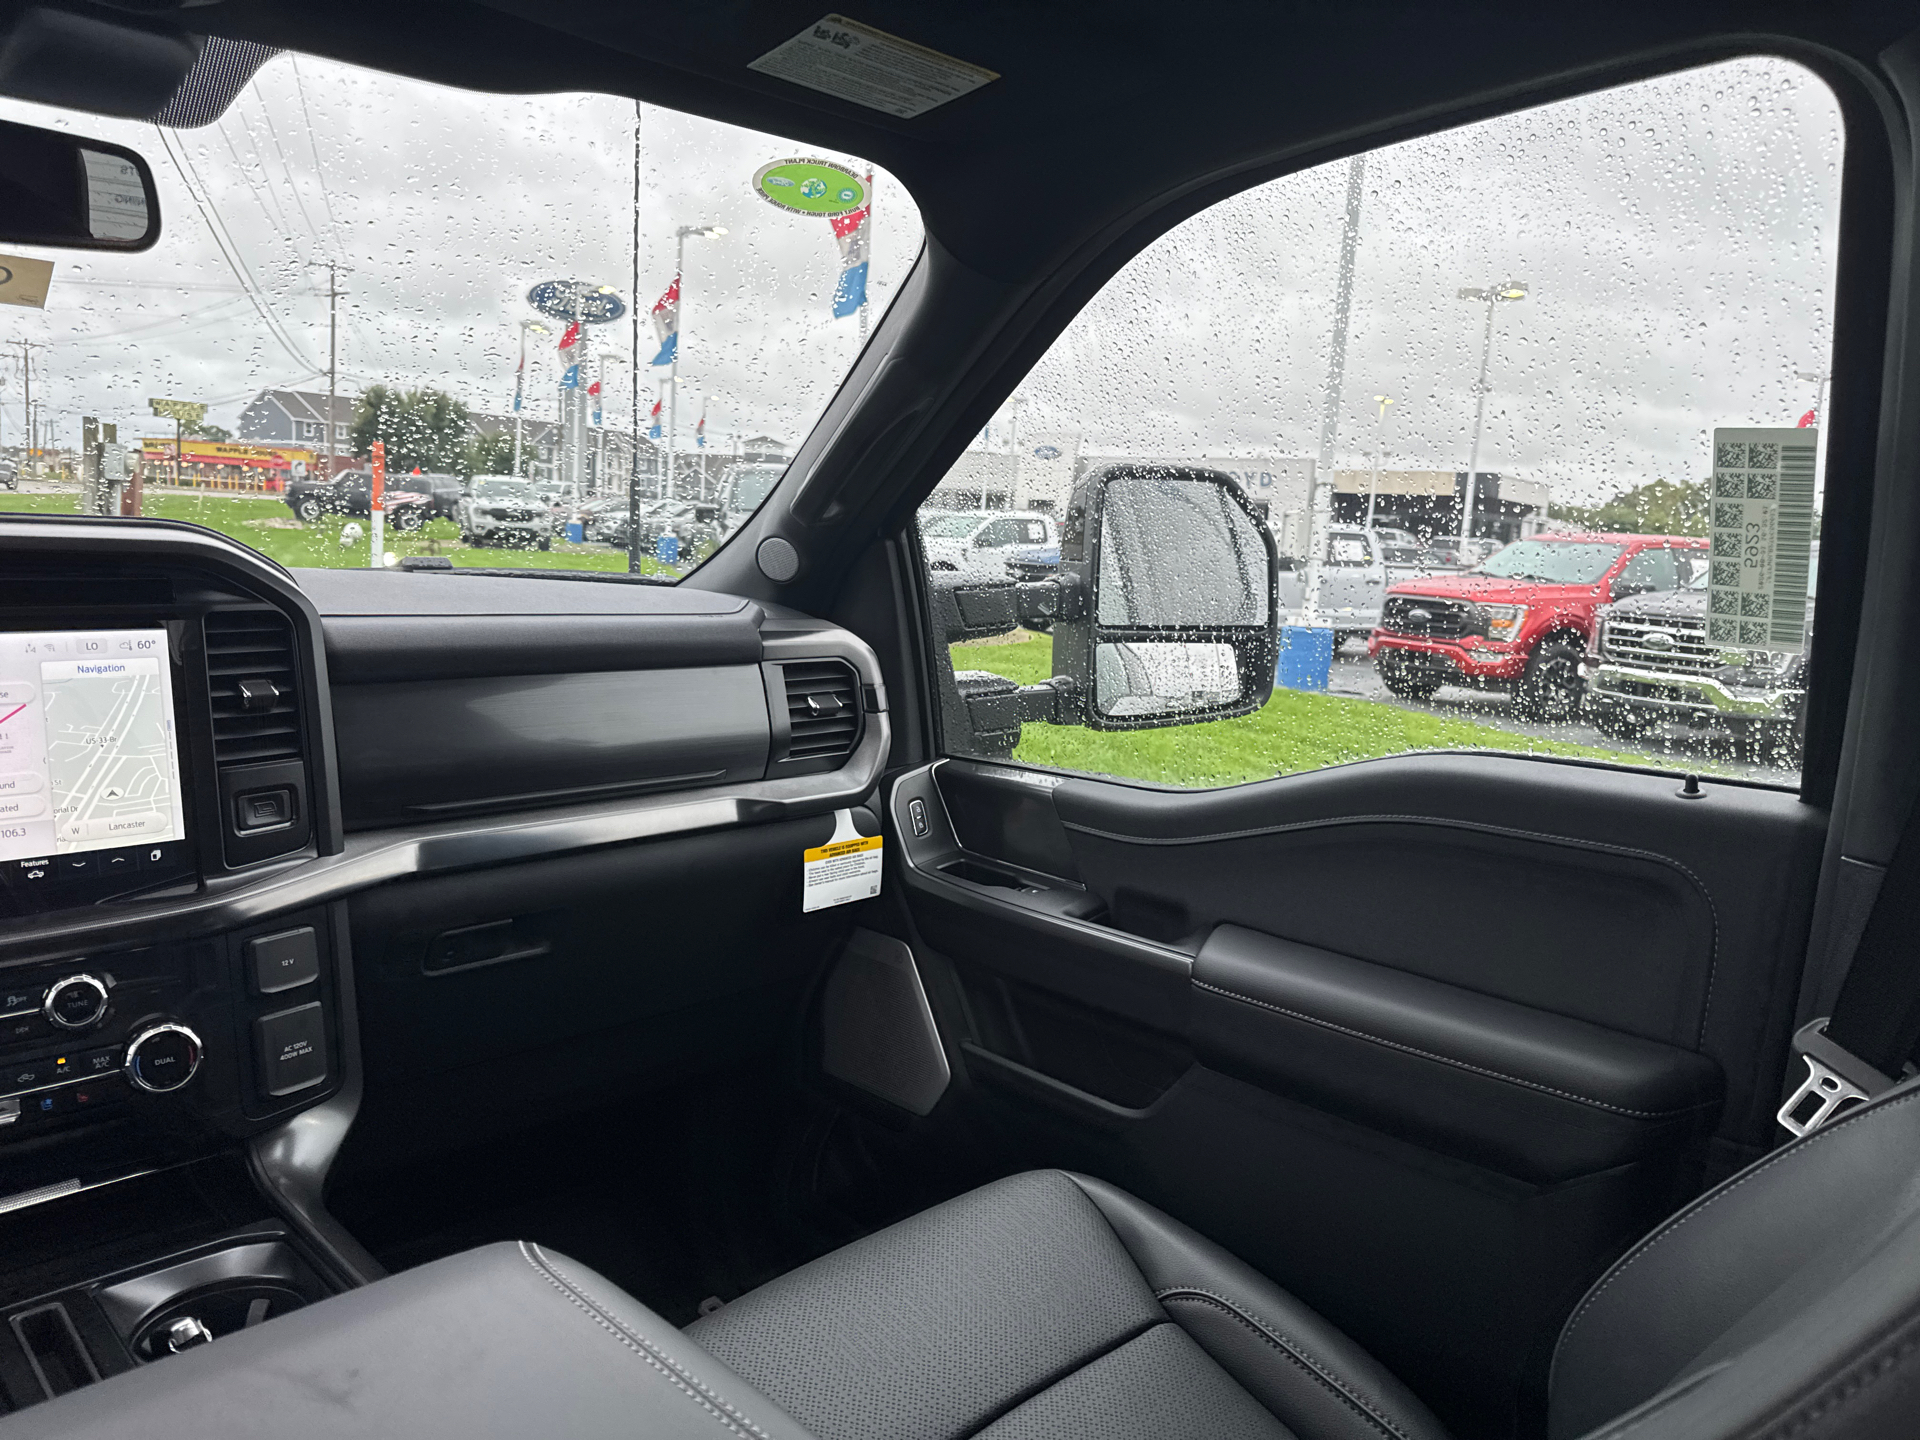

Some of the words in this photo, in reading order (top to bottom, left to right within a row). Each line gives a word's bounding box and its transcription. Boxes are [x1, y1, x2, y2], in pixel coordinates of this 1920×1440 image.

[86, 643, 98, 651] LO
[137, 640, 156, 650] 60°
[77, 664, 126, 674] Navigation
[108, 820, 146, 831] Lancaster
[1, 828, 26, 838] 106.3
[20, 859, 49, 868] Features
[66, 1000, 88, 1008] TUNE
[293, 1040, 308, 1050] 120V
[280, 1051, 298, 1060] 400W
[300, 1046, 312, 1056] MAX
[92, 1056, 110, 1064] MAX
[154, 1056, 176, 1066] DUAL
[56, 1066, 71, 1074] A/C
[96, 1061, 109, 1070] A/C
